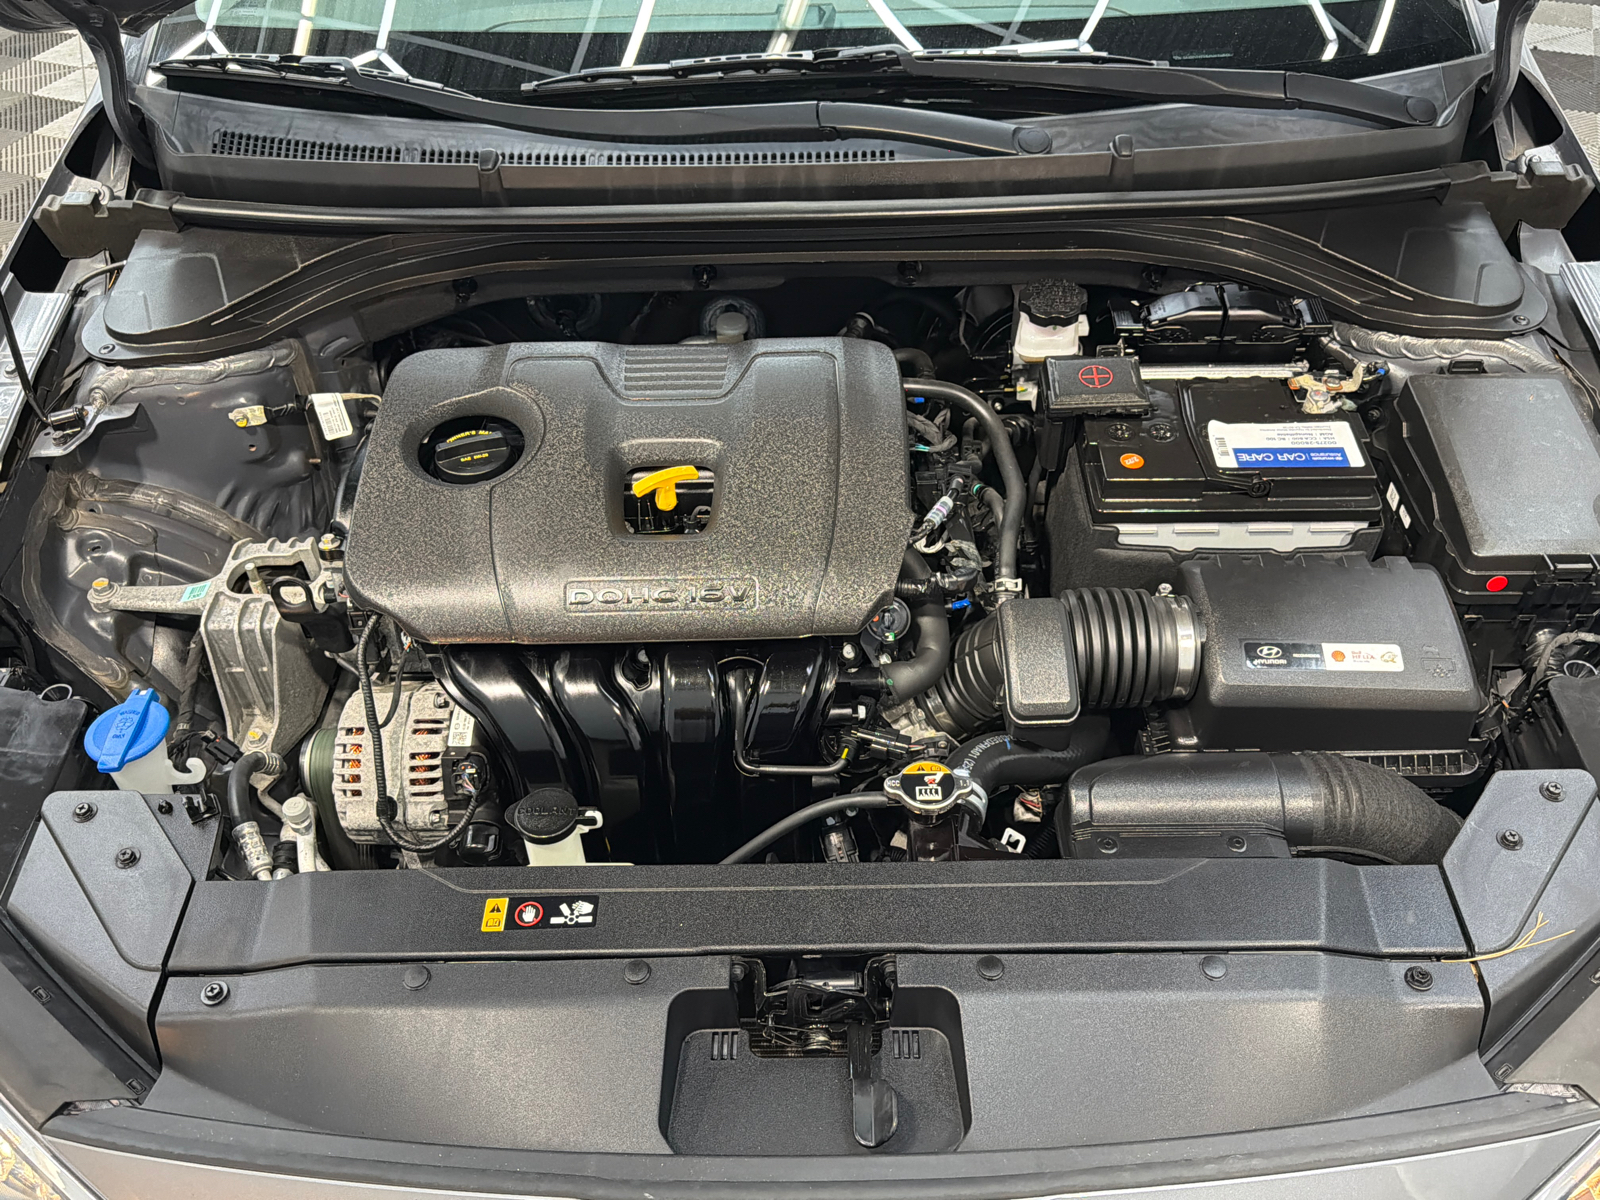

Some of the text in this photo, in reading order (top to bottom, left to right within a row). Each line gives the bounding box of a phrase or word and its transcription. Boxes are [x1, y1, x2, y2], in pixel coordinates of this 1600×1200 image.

[1237, 453, 1306, 461] CAR CARE
[568, 585, 751, 605] DOHC 16V
[518, 806, 577, 816] COOLANT
